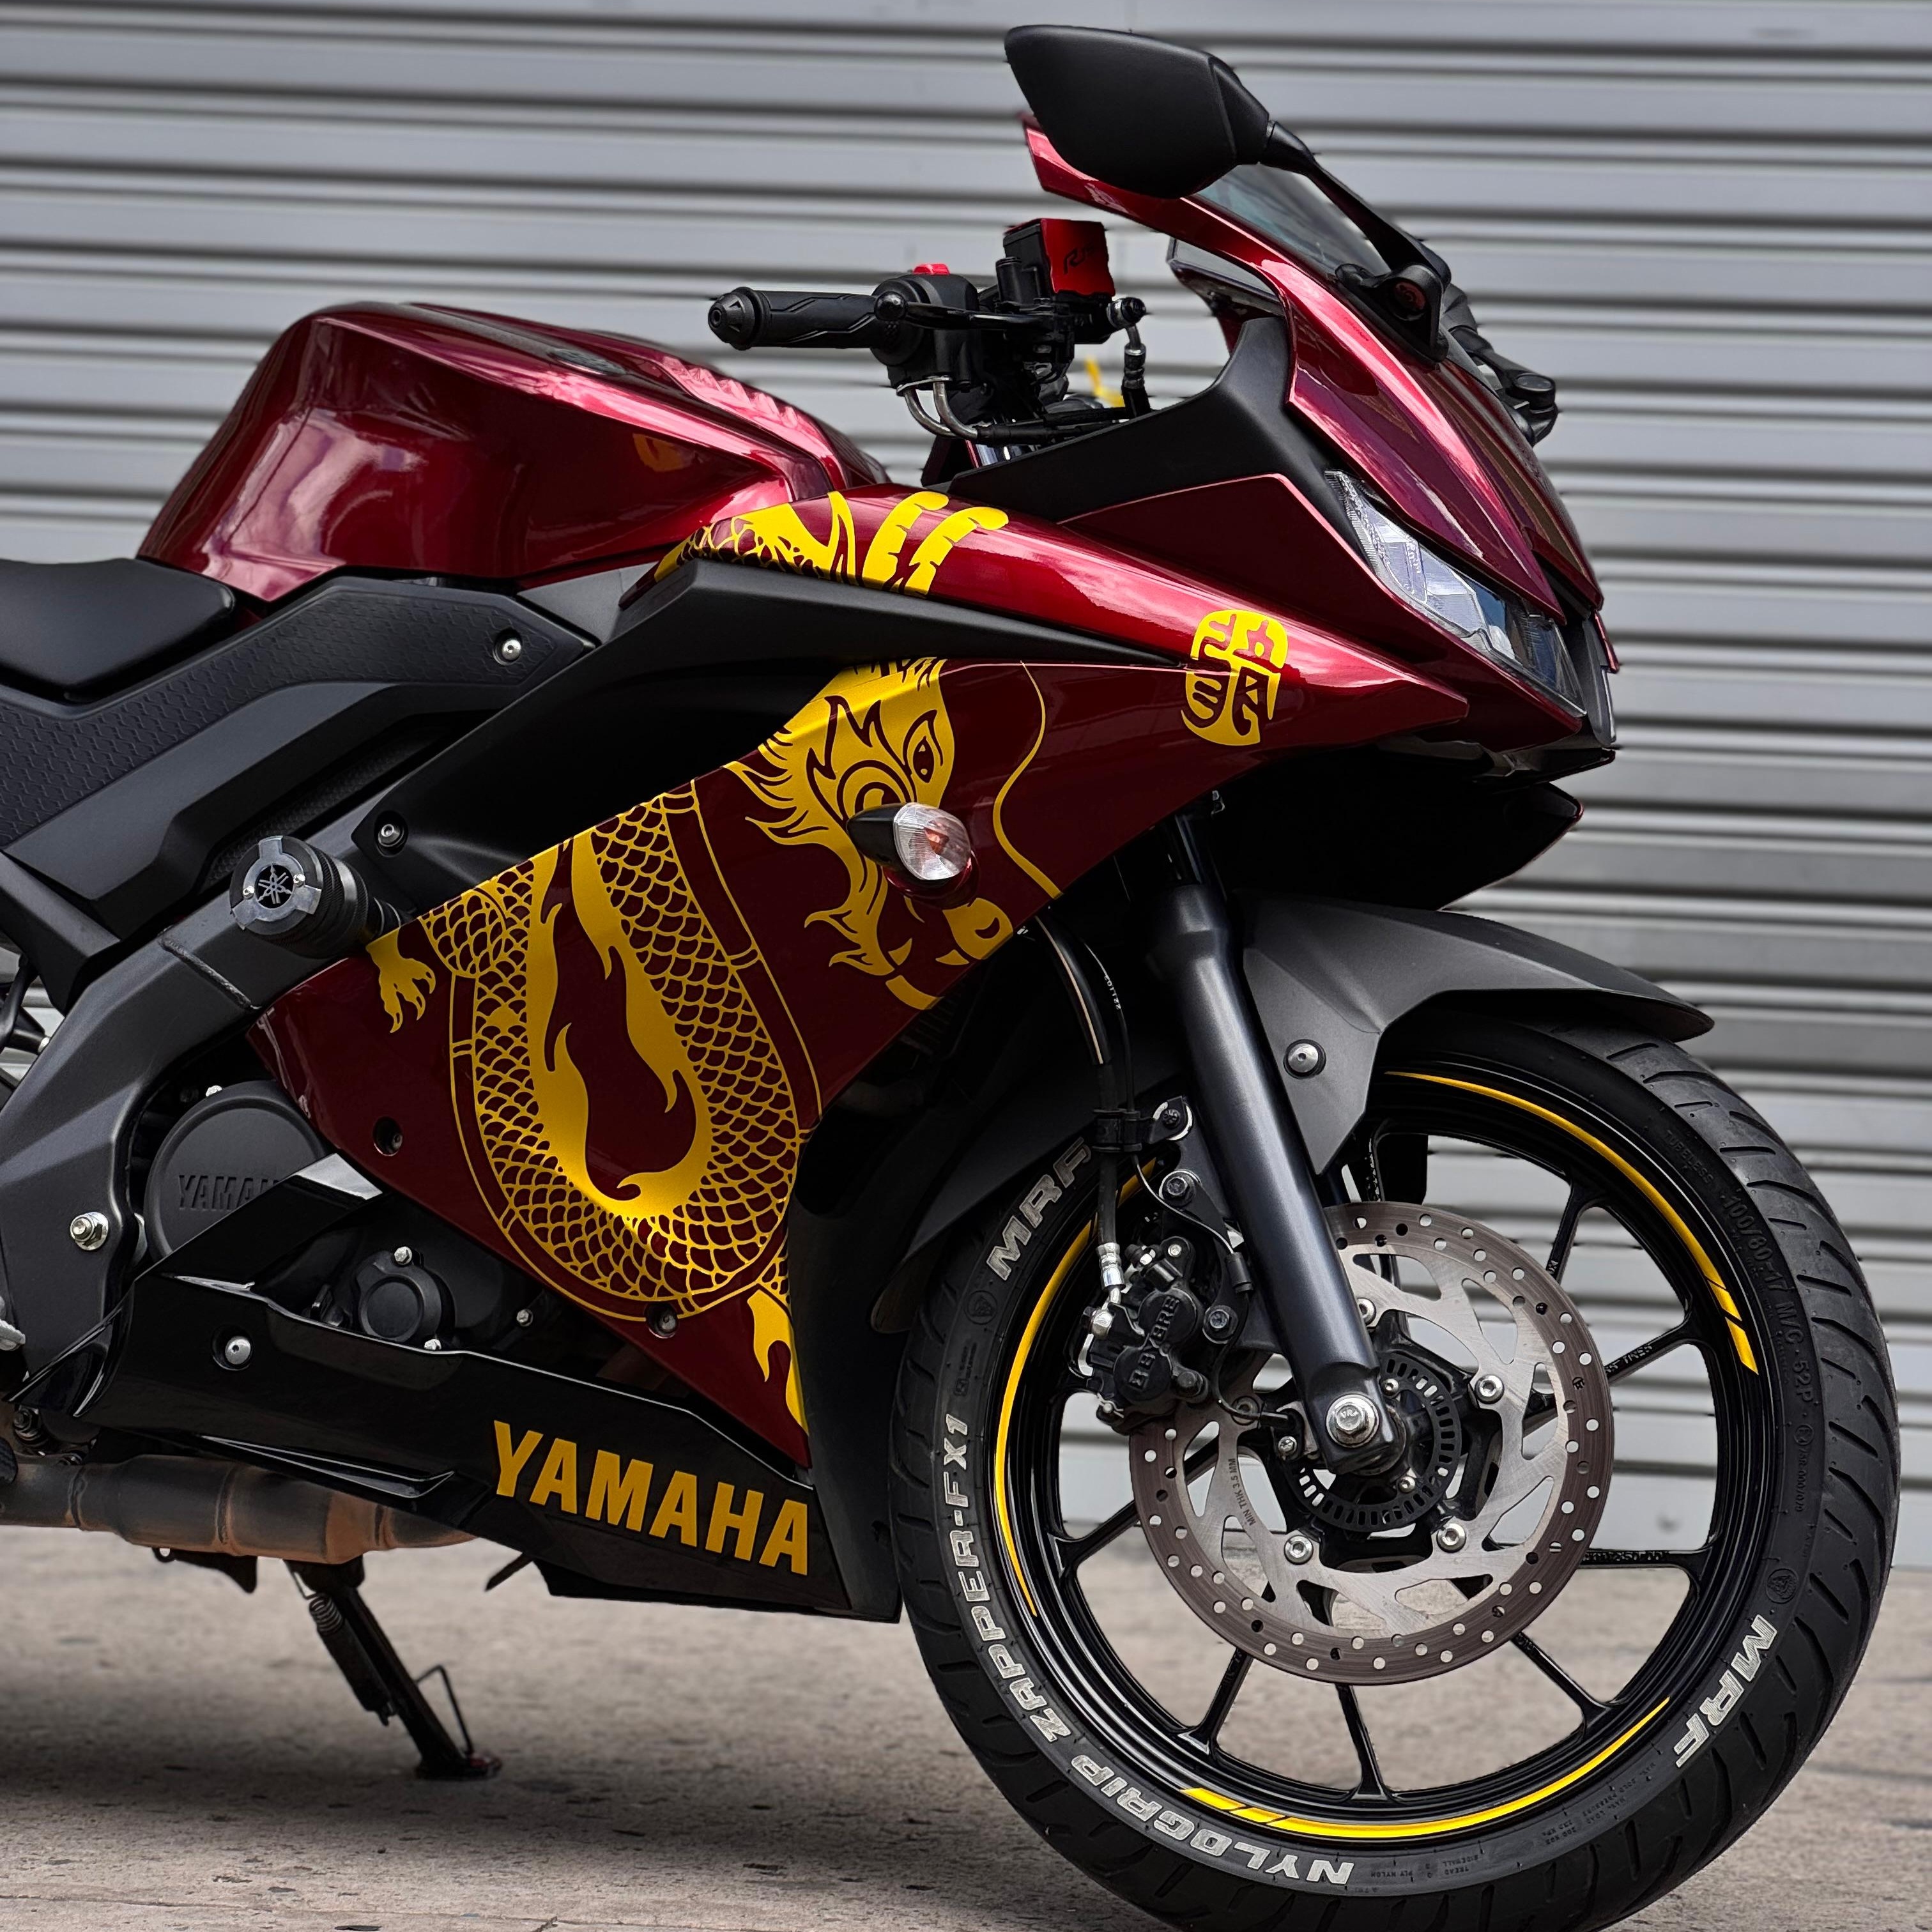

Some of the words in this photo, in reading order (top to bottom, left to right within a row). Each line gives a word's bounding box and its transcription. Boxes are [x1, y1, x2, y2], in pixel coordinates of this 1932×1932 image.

[1662, 1130, 1715, 1184] TUBELESS
[178, 1175, 279, 1211] YAMA
[986, 1137, 1092, 1281] MRF
[1793, 1360, 1814, 1402] 52P
[1228, 1458, 1238, 1473] MM
[1230, 1475, 1240, 1489] 3.5
[494, 1420, 808, 1575] YAMAHA
[1234, 1489, 1247, 1509] THK
[1243, 1509, 1257, 1526] MIN
[942, 1413, 1071, 1742] ZAPPER-FX1
[1673, 1614, 1778, 1768] MRF
[1070, 1755, 1354, 1885] NYLOGRIP
